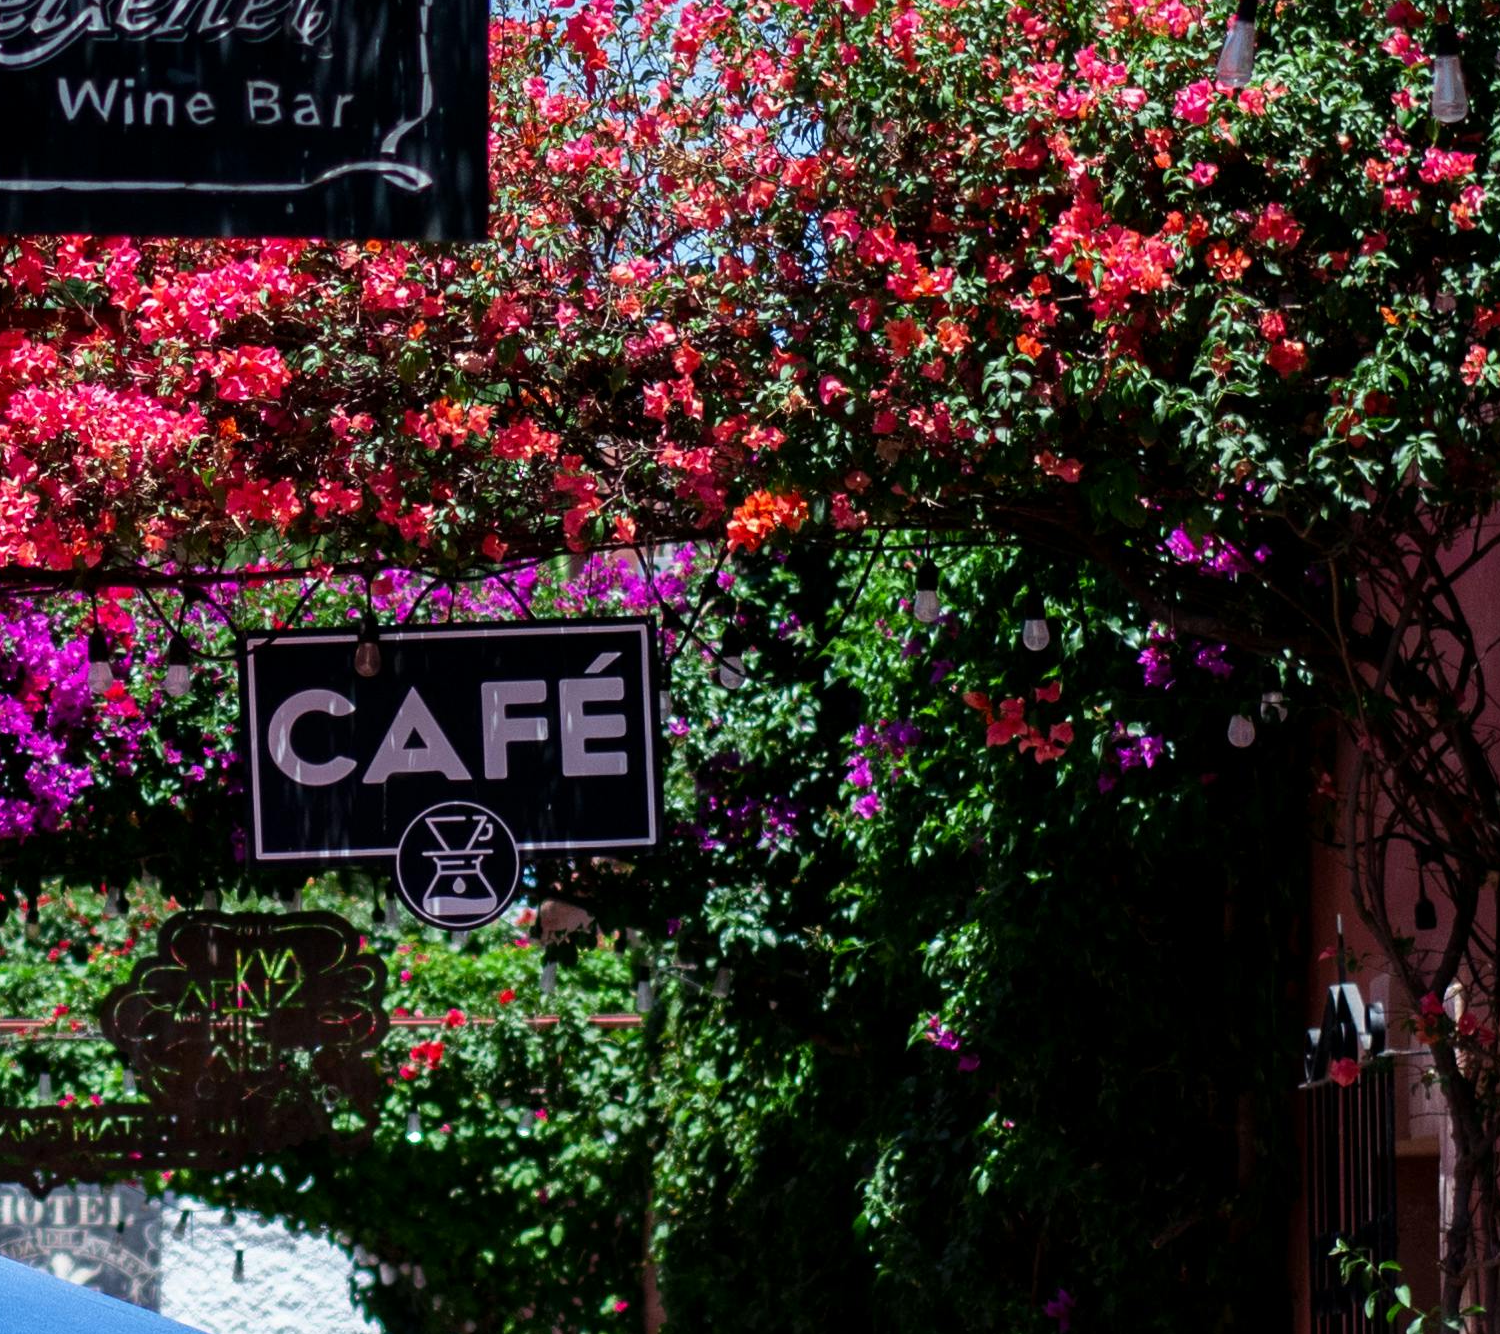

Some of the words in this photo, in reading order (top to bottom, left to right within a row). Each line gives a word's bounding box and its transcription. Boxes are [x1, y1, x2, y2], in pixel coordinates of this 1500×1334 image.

[57, 77, 216, 128] Wine
[247, 79, 354, 128] Bar
[268, 652, 629, 786] CAFÉ
